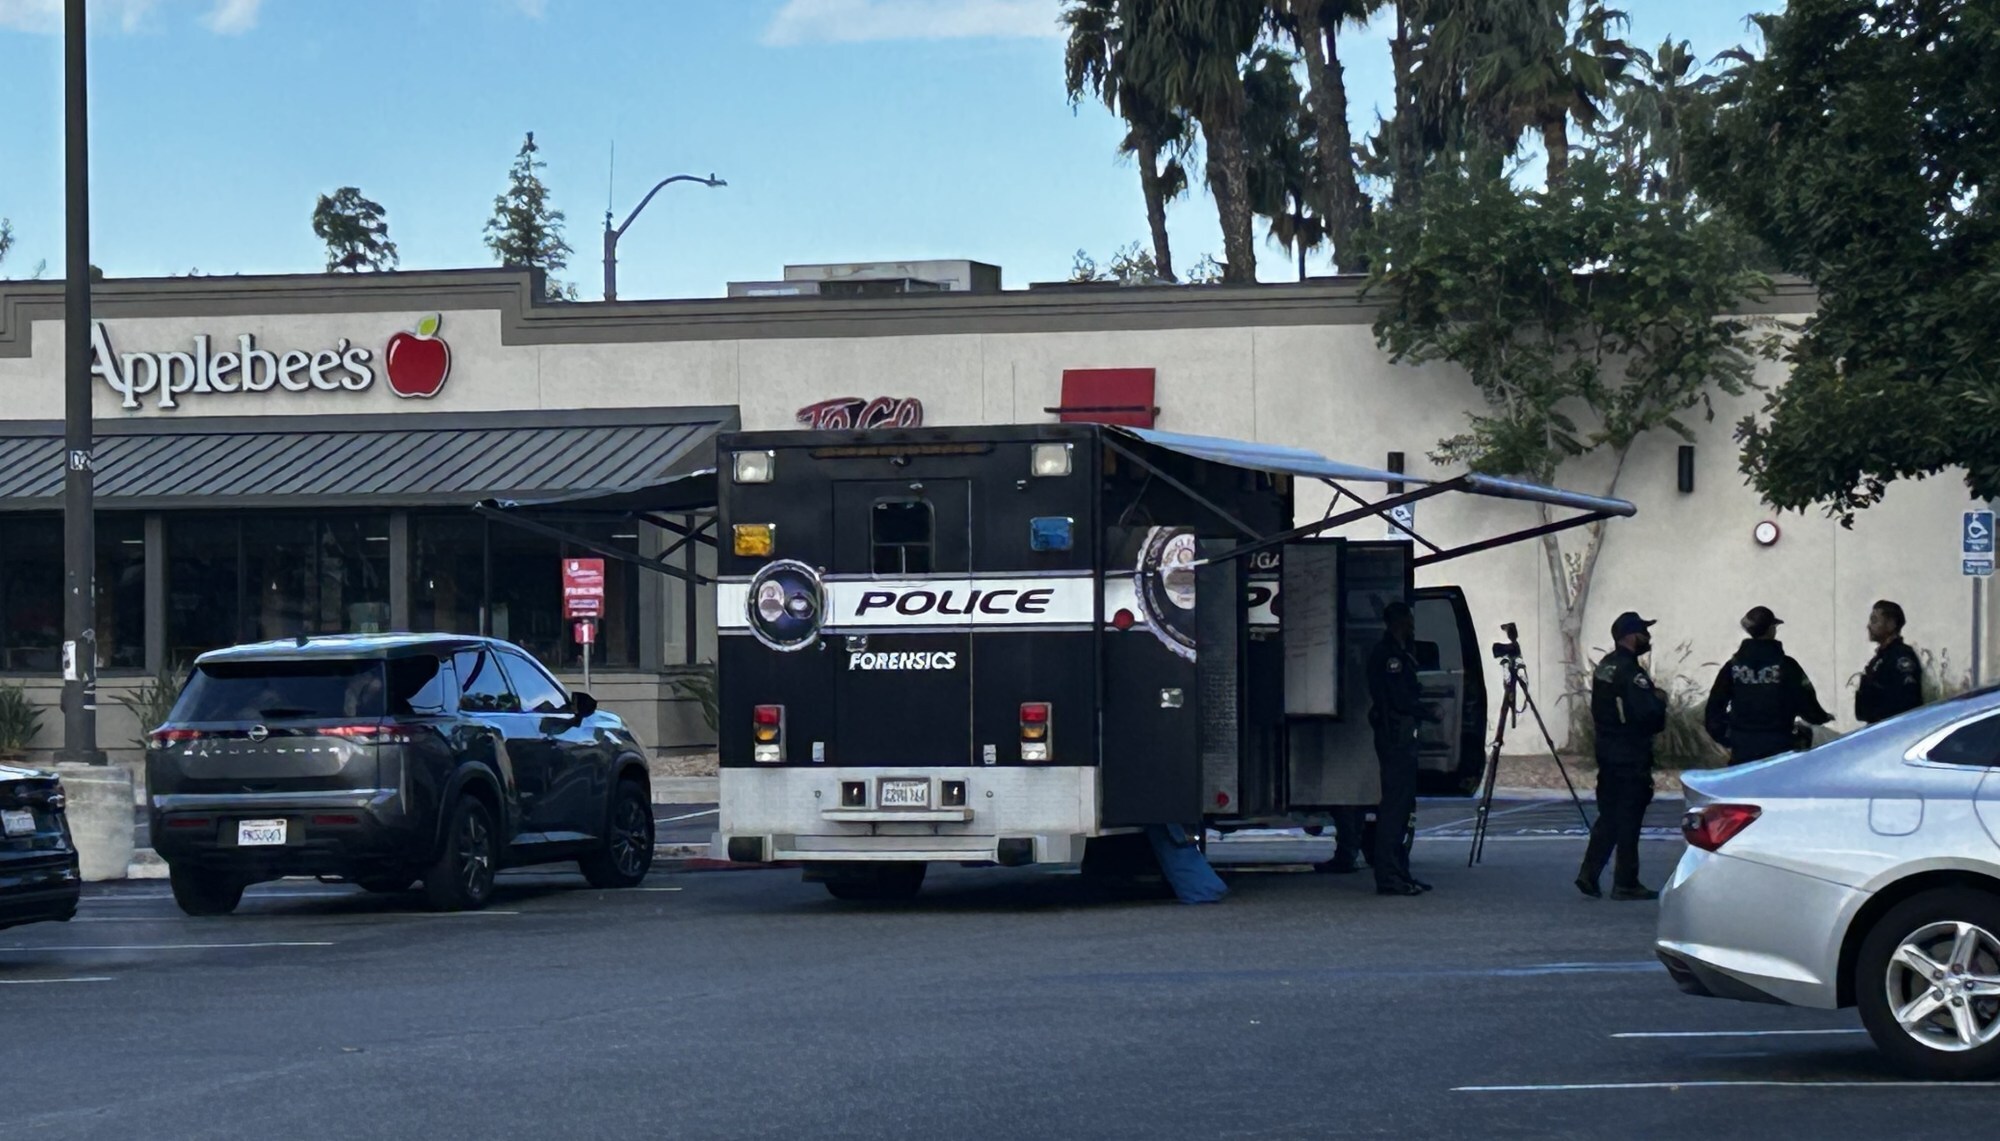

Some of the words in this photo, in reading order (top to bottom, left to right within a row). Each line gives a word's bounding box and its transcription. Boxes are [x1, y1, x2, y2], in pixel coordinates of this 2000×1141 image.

[91, 322, 375, 409] Applebee's
[855, 588, 1055, 616] POLICE
[849, 651, 957, 671] FORENSICS
[1731, 664, 1780, 685] POLICE
